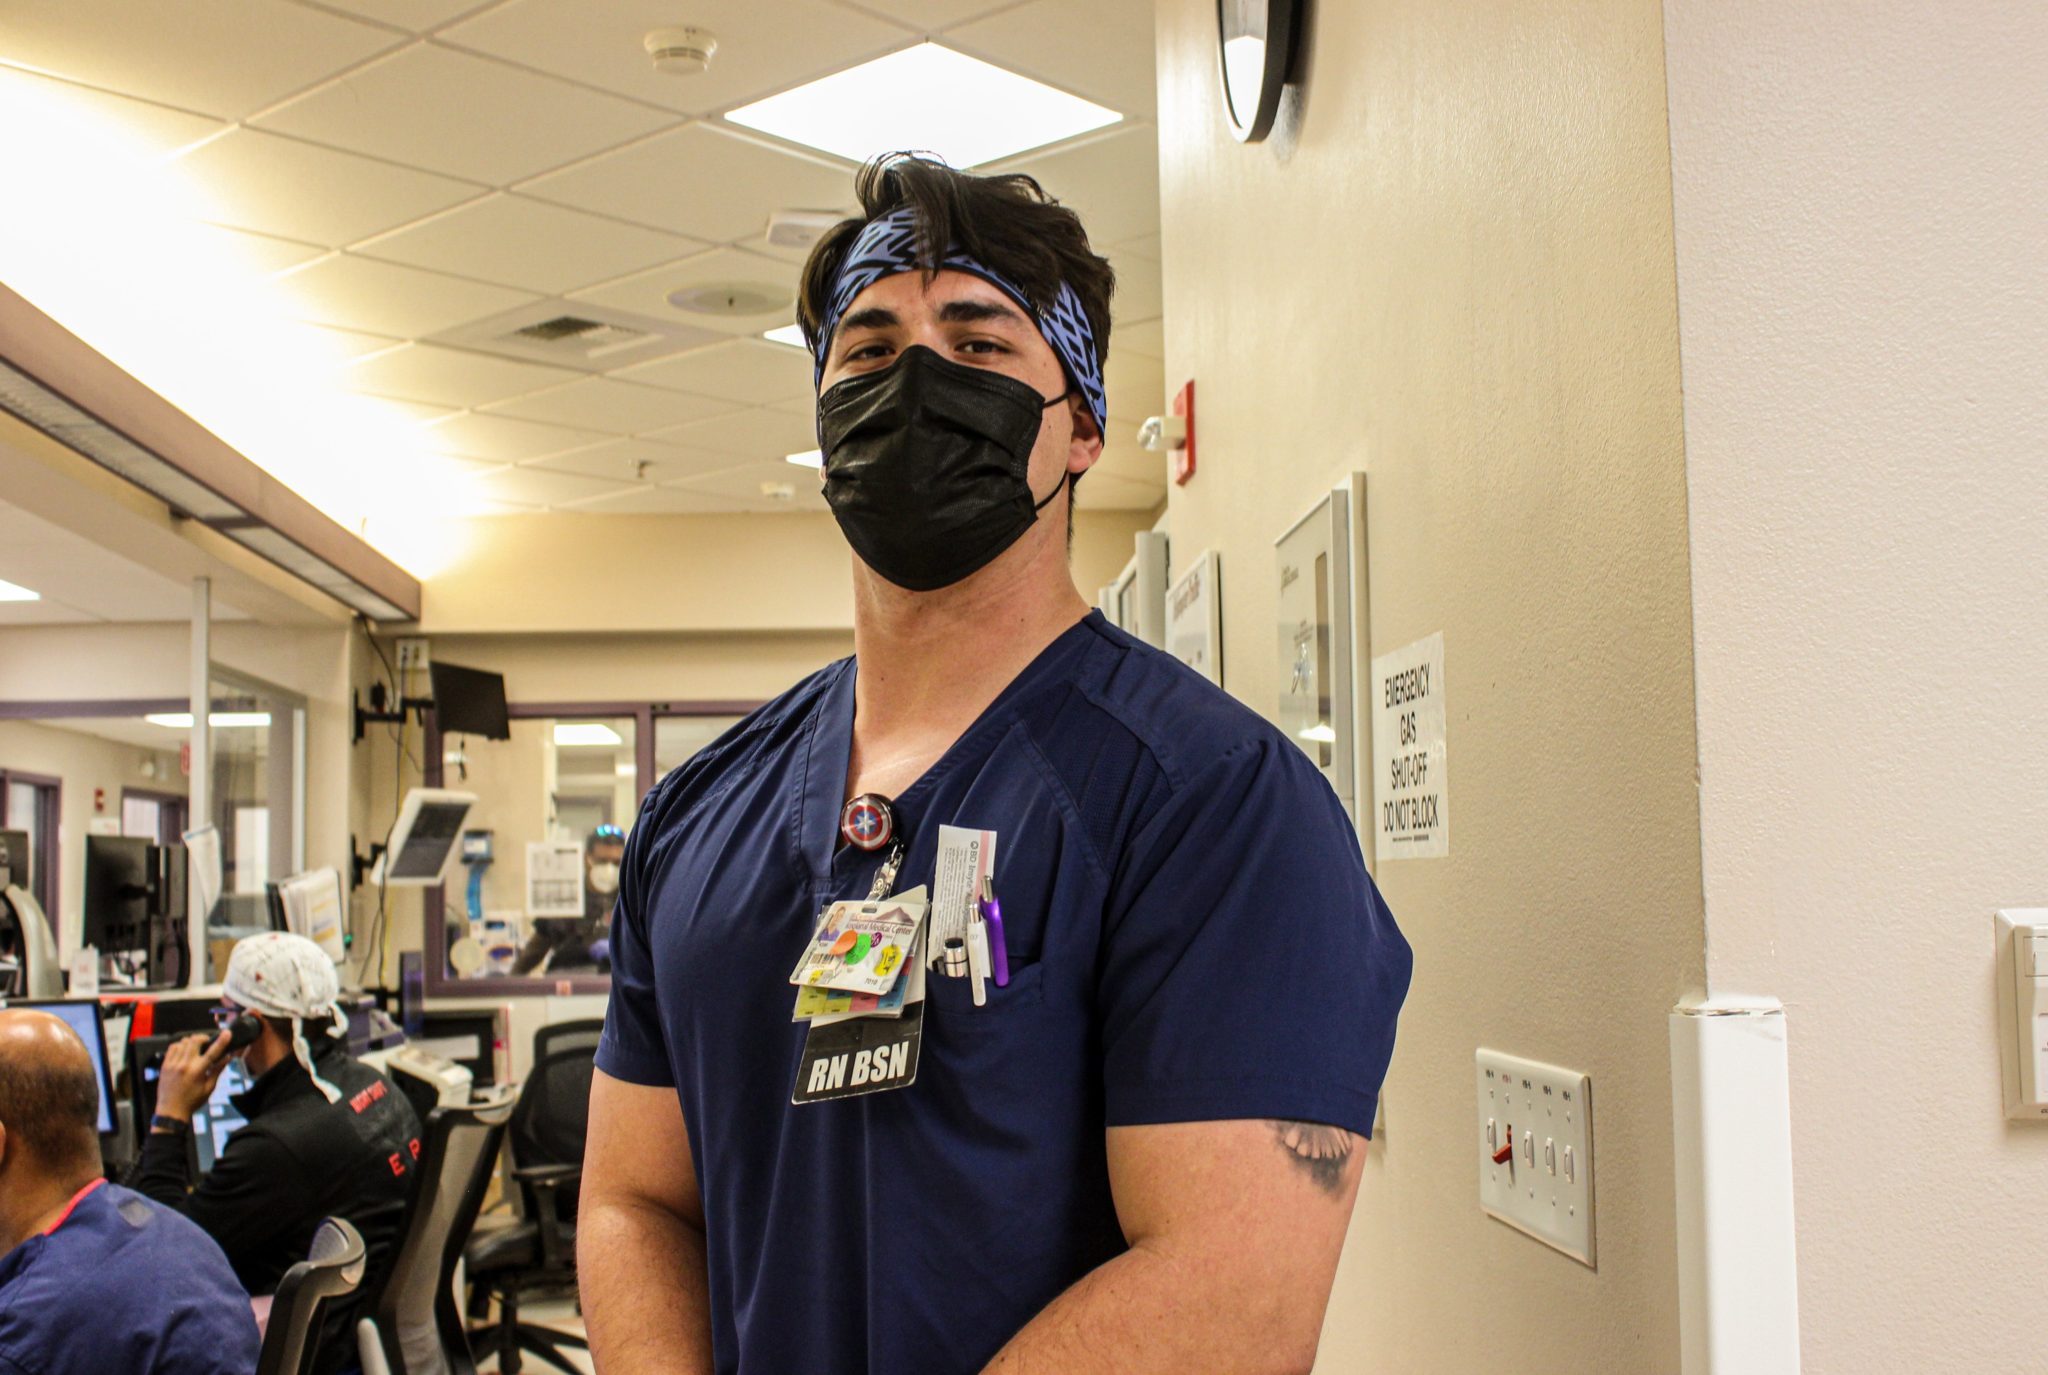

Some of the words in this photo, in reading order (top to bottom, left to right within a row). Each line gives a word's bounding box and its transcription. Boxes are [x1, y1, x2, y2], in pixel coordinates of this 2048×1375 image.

[1385, 662, 1430, 708] EMERGENCY
[1400, 711, 1416, 746] GAS
[1391, 752, 1427, 790] SHUT-OFF
[1383, 801, 1394, 832] DO
[1395, 798, 1410, 831] NOT
[1412, 793, 1438, 829] BLOCK
[892, 925, 912, 935] Center
[807, 1053, 849, 1093] RN
[850, 1040, 909, 1086] BSN
